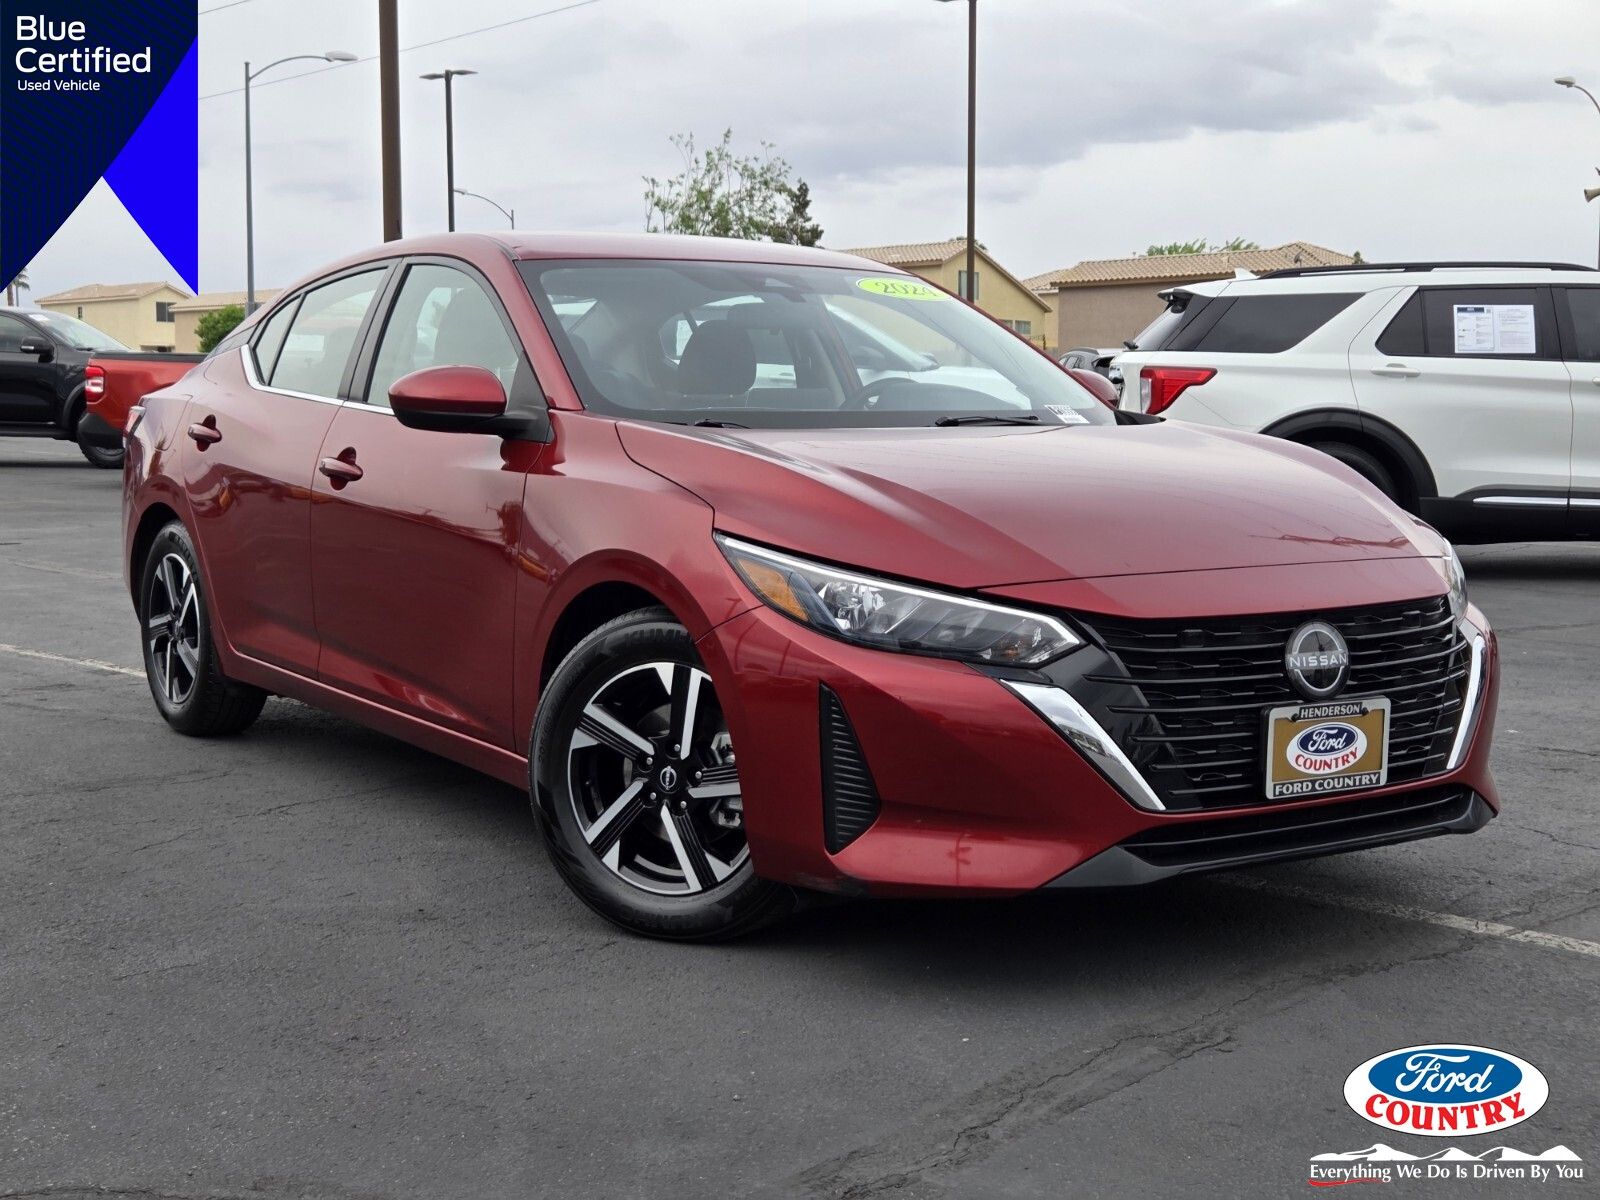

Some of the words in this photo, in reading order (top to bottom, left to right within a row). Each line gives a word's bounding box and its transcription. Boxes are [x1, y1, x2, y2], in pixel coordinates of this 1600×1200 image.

[1289, 653, 1347, 667] NISSAN
[1300, 703, 1360, 718] HENDERSON
[1307, 729, 1348, 752] Ford
[1294, 746, 1359, 771] COUNTRY
[1275, 781, 1313, 796] FORD
[1314, 772, 1380, 792] COUNTRY
